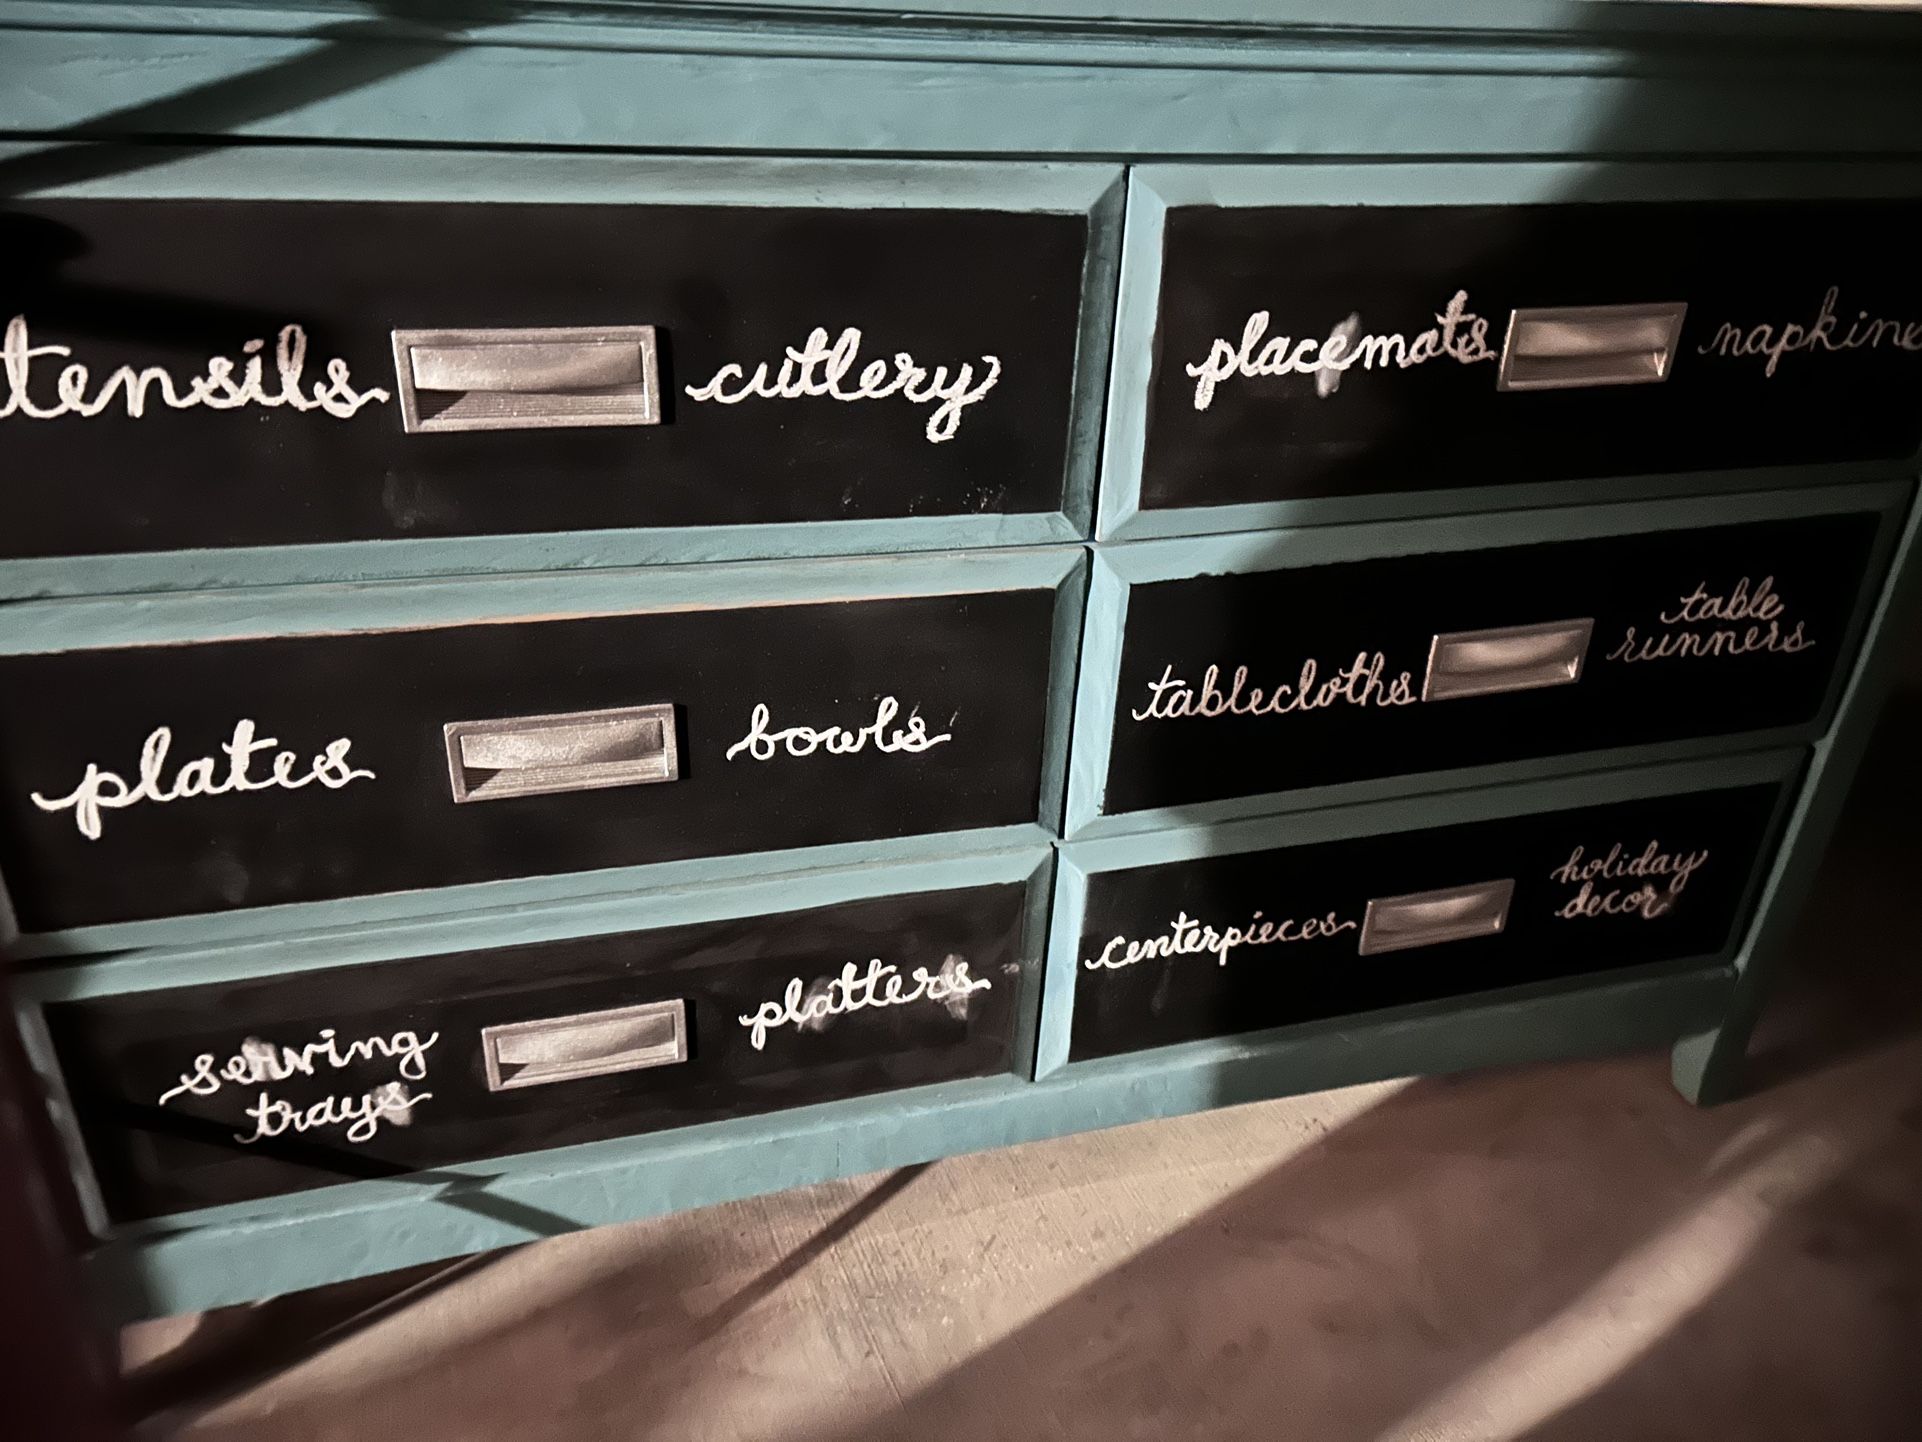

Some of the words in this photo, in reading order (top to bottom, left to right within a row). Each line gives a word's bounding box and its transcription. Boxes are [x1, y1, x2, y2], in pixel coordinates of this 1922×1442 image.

[1186, 289, 1496, 412] placemats
[685, 326, 1001, 444] cutlery
[1659, 575, 1785, 624] table
[1605, 617, 1815, 663] runners
[1131, 651, 1418, 722] tablecloths
[726, 695, 952, 761] bowls
[30, 718, 375, 841] plates
[1550, 839, 1709, 894] holiday
[1554, 881, 1670, 920] decor
[1084, 911, 1357, 971] centerpieces
[738, 957, 993, 1051] platters
[158, 1028, 440, 1107] serving
[233, 1081, 433, 1144] trays
